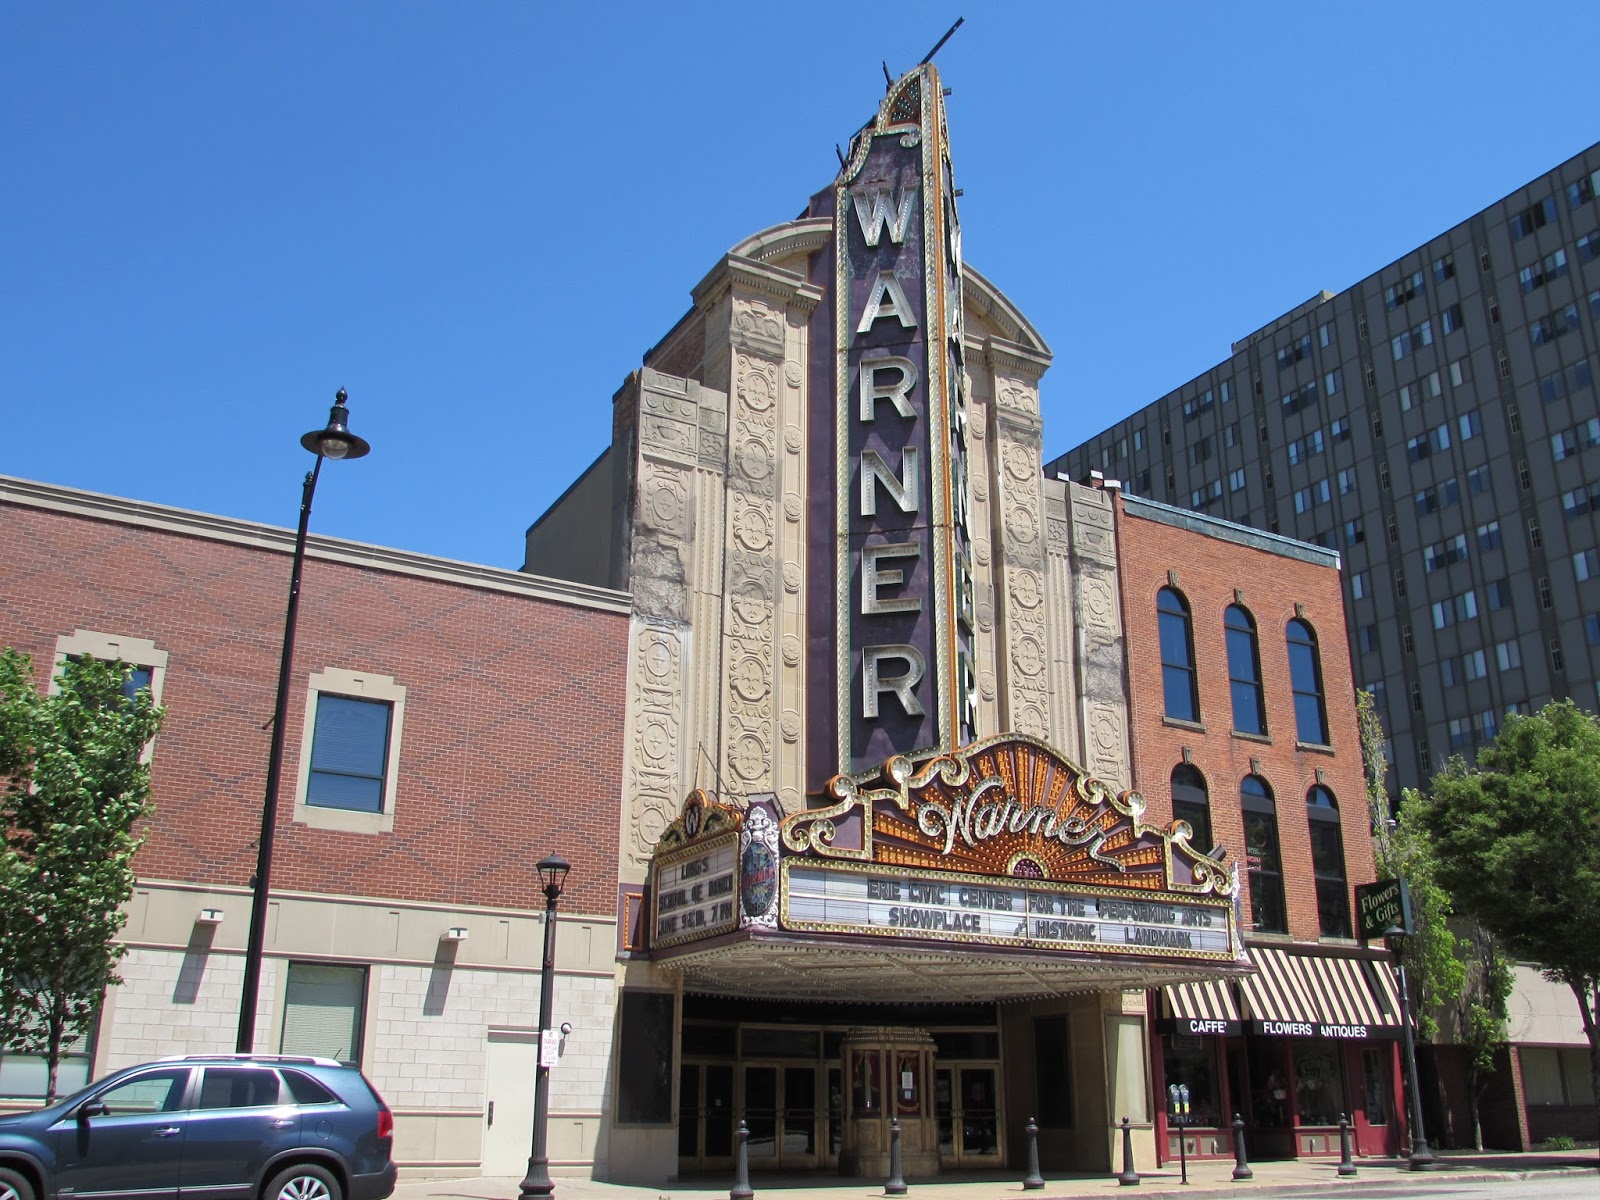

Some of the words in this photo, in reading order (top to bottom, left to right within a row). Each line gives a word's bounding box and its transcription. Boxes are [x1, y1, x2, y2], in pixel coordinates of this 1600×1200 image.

[851, 185, 925, 718] WARNER
[917, 775, 1126, 873] Warner
[659, 889, 687, 912] SCHOOL
[708, 874, 733, 897] DANCE
[867, 879, 901, 900] ERIE
[908, 883, 946, 905] CIVIC
[958, 887, 1013, 911] CENTER
[1028, 894, 1054, 914] FOR
[1059, 898, 1085, 917] THE
[1099, 901, 1176, 925] PERFORMING
[1181, 908, 1212, 927] ARTS
[1361, 883, 1399, 914] Flowers
[660, 916, 677, 936] JUNE
[720, 901, 733, 921] PM
[888, 907, 981, 933] SHOWPLACE
[1035, 920, 1097, 941] HISTORIC
[1124, 926, 1192, 949] LANDMARK
[1365, 915, 1374, 929] &
[1376, 902, 1399, 922] Gifts
[1263, 1021, 1313, 1036] FLOWERS
[1320, 1024, 1367, 1038] ANTIQUES
